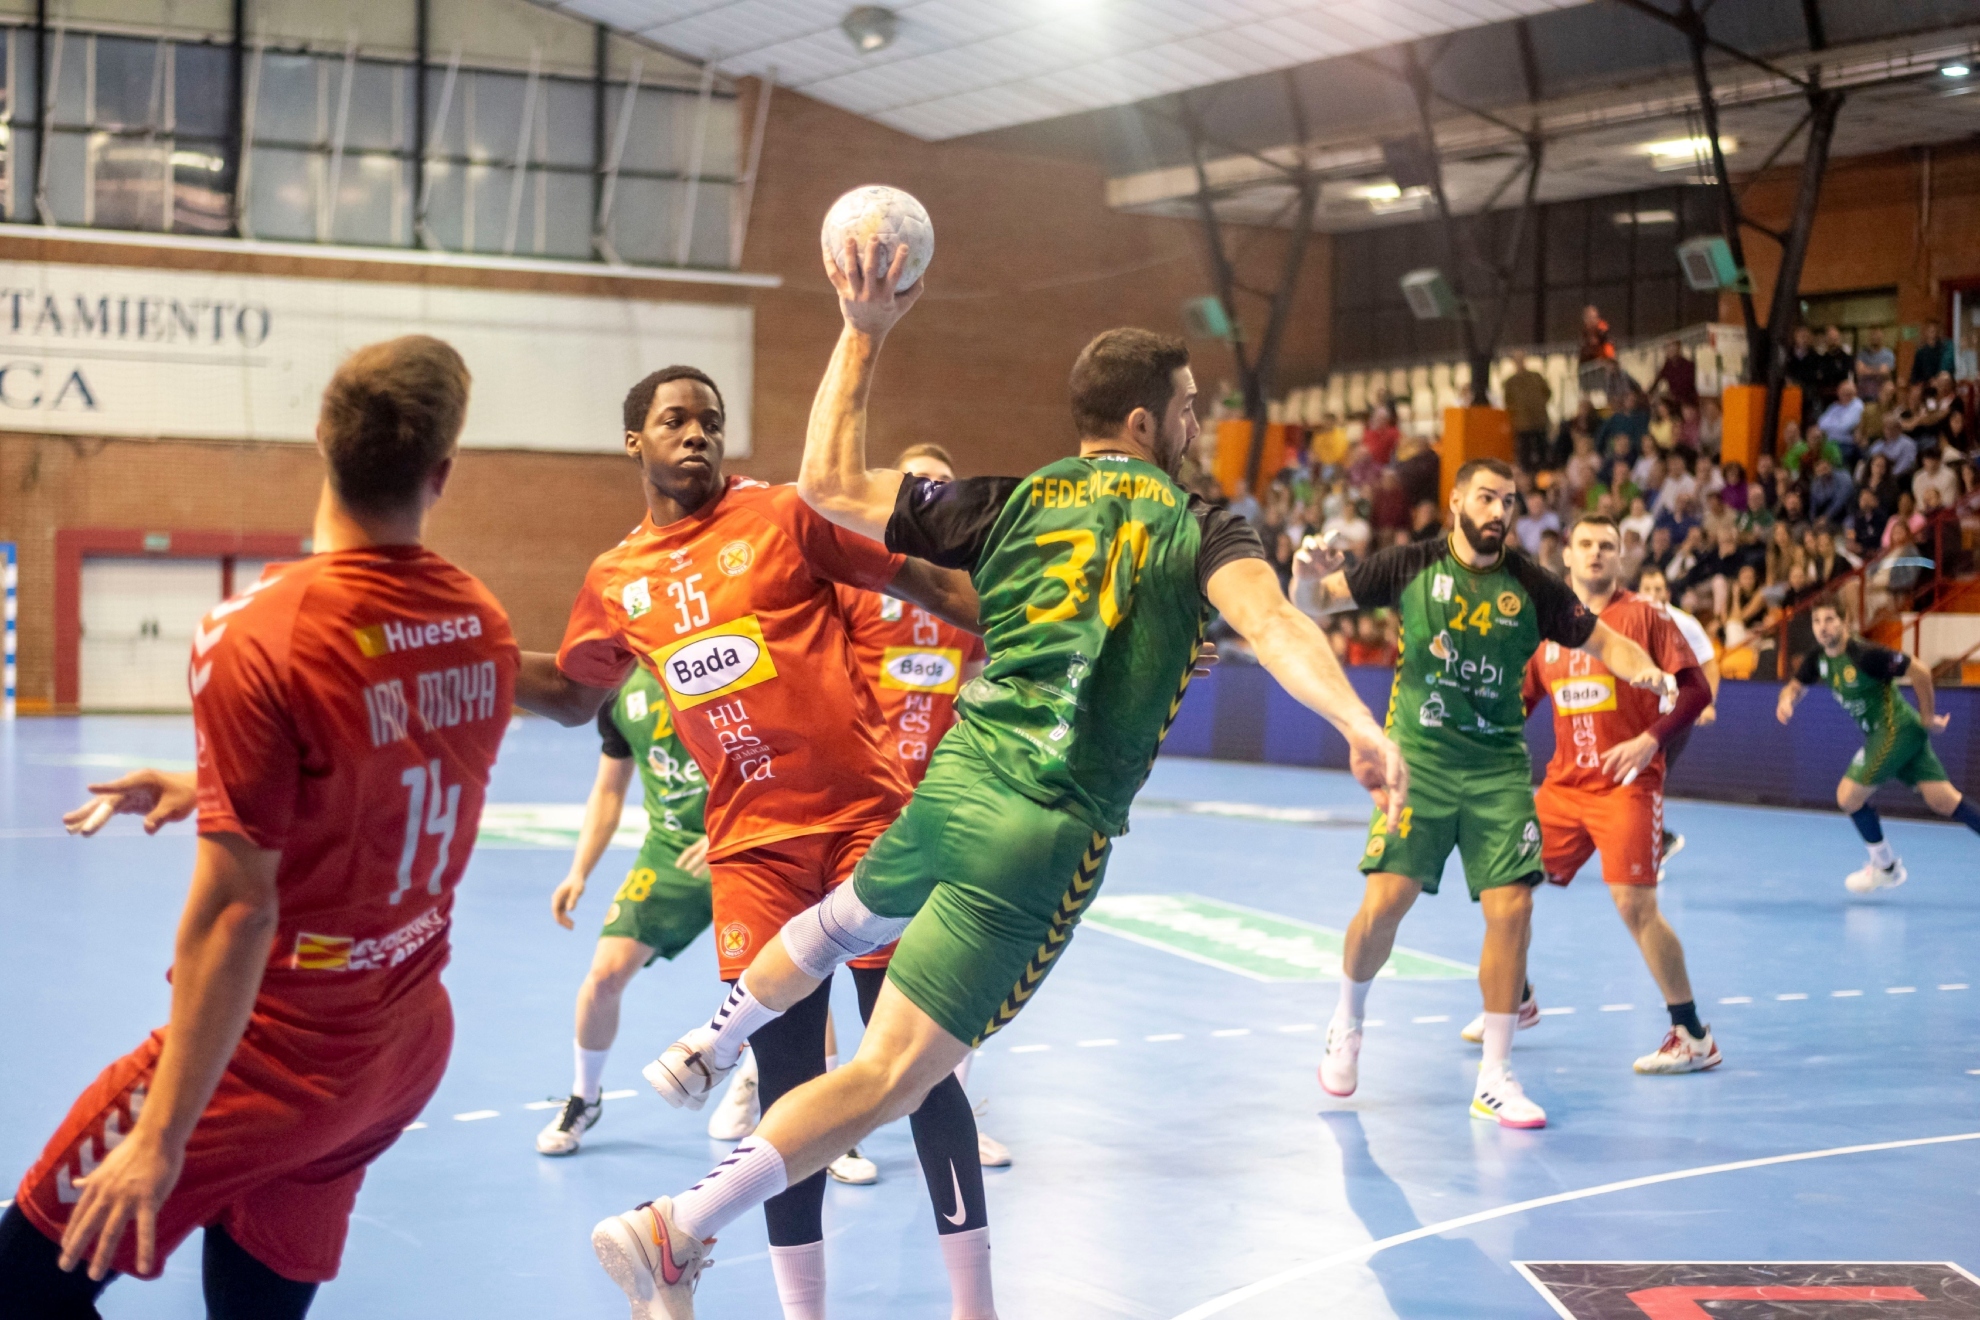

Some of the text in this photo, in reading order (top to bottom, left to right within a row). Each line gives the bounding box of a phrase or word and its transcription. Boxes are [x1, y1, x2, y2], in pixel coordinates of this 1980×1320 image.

[1, 287, 271, 349] TAMIENTO
[0, 360, 102, 412] CA
[1026, 519, 1150, 631] 30
[667, 573, 710, 634] 35
[1449, 595, 1492, 636] 24
[383, 614, 482, 652] Huesca
[672, 646, 741, 685] Bada
[901, 659, 944, 677] Bada
[417, 661, 497, 733] MOYA
[1562, 688, 1598, 702] Bada
[718, 724, 761, 754] es
[739, 754, 776, 782] ca
[388, 758, 462, 905] 14
